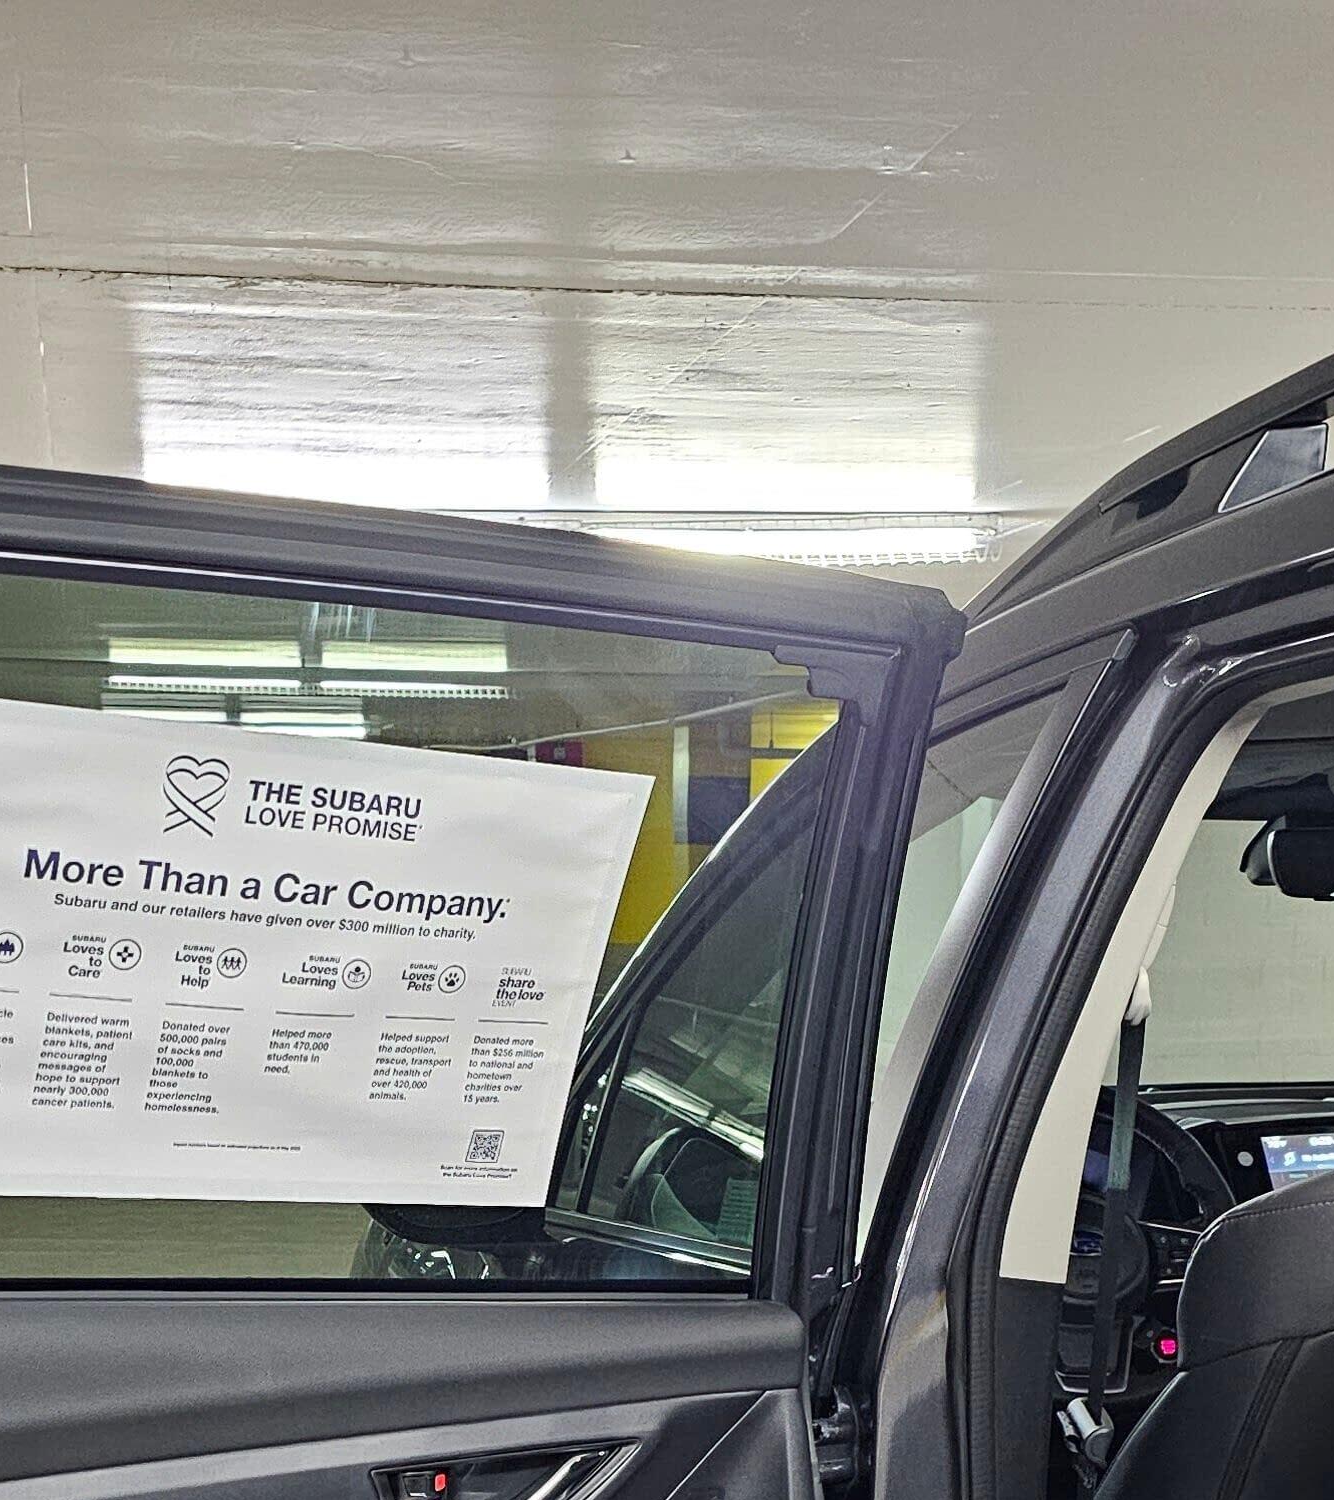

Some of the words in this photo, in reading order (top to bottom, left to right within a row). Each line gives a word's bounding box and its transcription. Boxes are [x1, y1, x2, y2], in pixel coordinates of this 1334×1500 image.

[249, 780, 303, 805] THE
[311, 787, 421, 819] SUBARU
[244, 805, 306, 829] LOVE
[24, 848, 124, 887] More
[139, 859, 228, 897] Than
[240, 878, 261, 900] a
[274, 873, 338, 905] Car
[54, 894, 107, 909] Subaru
[111, 901, 138, 912] and
[142, 904, 166, 914] our
[170, 906, 226, 920] retailers
[230, 910, 262, 923] have
[266, 914, 302, 927] given
[306, 919, 336, 929] over
[339, 919, 369, 932] $300
[372, 923, 414, 936] million
[419, 926, 430, 937] to
[434, 927, 475, 942] charity.
[63, 941, 104, 955] Loves
[89, 956, 102, 967] to
[175, 951, 212, 964] Loves
[68, 965, 102, 979] Care
[199, 965, 210, 975] to
[301, 962, 338, 976] Loves
[402, 969, 435, 981] Loves
[181, 975, 211, 990] Help
[282, 972, 336, 990] Learning
[407, 981, 434, 992] Pets
[499, 976, 535, 989] share
[47, 1012, 98, 1024] Delivered
[101, 1018, 129, 1027] warm
[162, 1021, 205, 1032] Donated
[96, 1030, 132, 1040] patient
[160, 1033, 199, 1044] 500,000
[201, 1037, 226, 1046] pairs
[272, 1029, 306, 1039] Helped
[381, 1033, 413, 1043] Helped
[415, 1035, 449, 1044] support
[94, 1042, 114, 1050] and
[269, 1041, 290, 1049] than
[293, 1041, 329, 1051] 470,000
[474, 1036, 510, 1045] Donated
[158, 1045, 168, 1054] of
[171, 1047, 200, 1056] socks
[203, 1049, 222, 1058] and
[379, 1045, 392, 1053] the
[471, 1048, 490, 1056] than
[493, 1048, 513, 1057] $256
[515, 1050, 544, 1058] million
[40, 1051, 107, 1063] encouraging
[156, 1057, 194, 1067] 100,000
[267, 1053, 308, 1062] students
[311, 1054, 319, 1063] in
[38, 1063, 92, 1073] messages
[95, 1064, 106, 1072] of
[411, 1058, 451, 1068] transport
[469, 1059, 477, 1067] to
[480, 1060, 515, 1069] national
[152, 1067, 195, 1078] blankets
[199, 1071, 208, 1079] to
[373, 1067, 390, 1076] and
[393, 1068, 420, 1077] health
[423, 1069, 432, 1077] of
[467, 1071, 512, 1080] hometown
[35, 1072, 62, 1083] hope
[66, 1075, 76, 1083] to
[80, 1077, 120, 1086] support
[150, 1079, 178, 1088] those
[33, 1085, 66, 1096] nearly
[69, 1086, 109, 1096] 300,000
[394, 1080, 427, 1090] 420,000
[465, 1083, 501, 1091] charities
[32, 1098, 68, 1107] cancer
[147, 1092, 211, 1103] experiencing
[464, 1094, 473, 1102] 15
